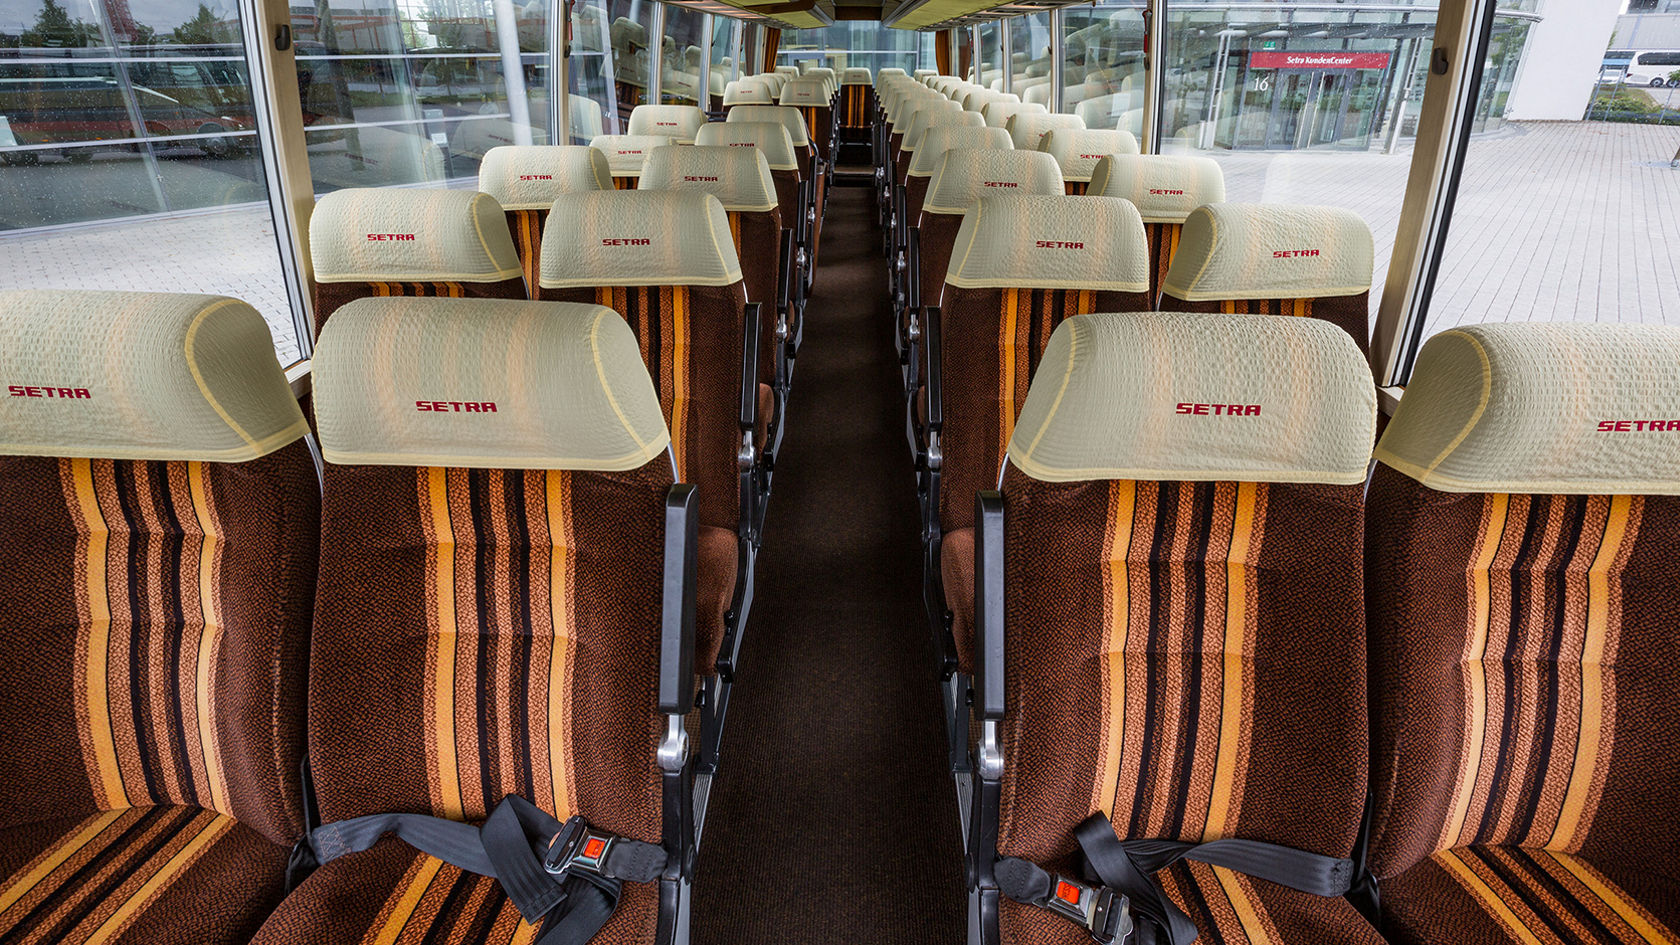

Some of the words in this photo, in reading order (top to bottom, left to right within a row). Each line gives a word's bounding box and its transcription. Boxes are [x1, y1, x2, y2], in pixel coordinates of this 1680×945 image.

[1286, 56, 1304, 65] Setra
[1304, 56, 1353, 65] KundenCenter
[1253, 76, 1269, 91] 16
[1149, 188, 1184, 196] SETRA
[366, 233, 415, 242] SETRA
[602, 238, 651, 246] SETRA
[1035, 241, 1084, 249] SETRA
[1272, 249, 1320, 259] SETRA
[8, 385, 92, 399] SETRA
[416, 401, 498, 413] SETRA
[1175, 402, 1262, 416] SETRA
[1597, 420, 1680, 432] SETRA
